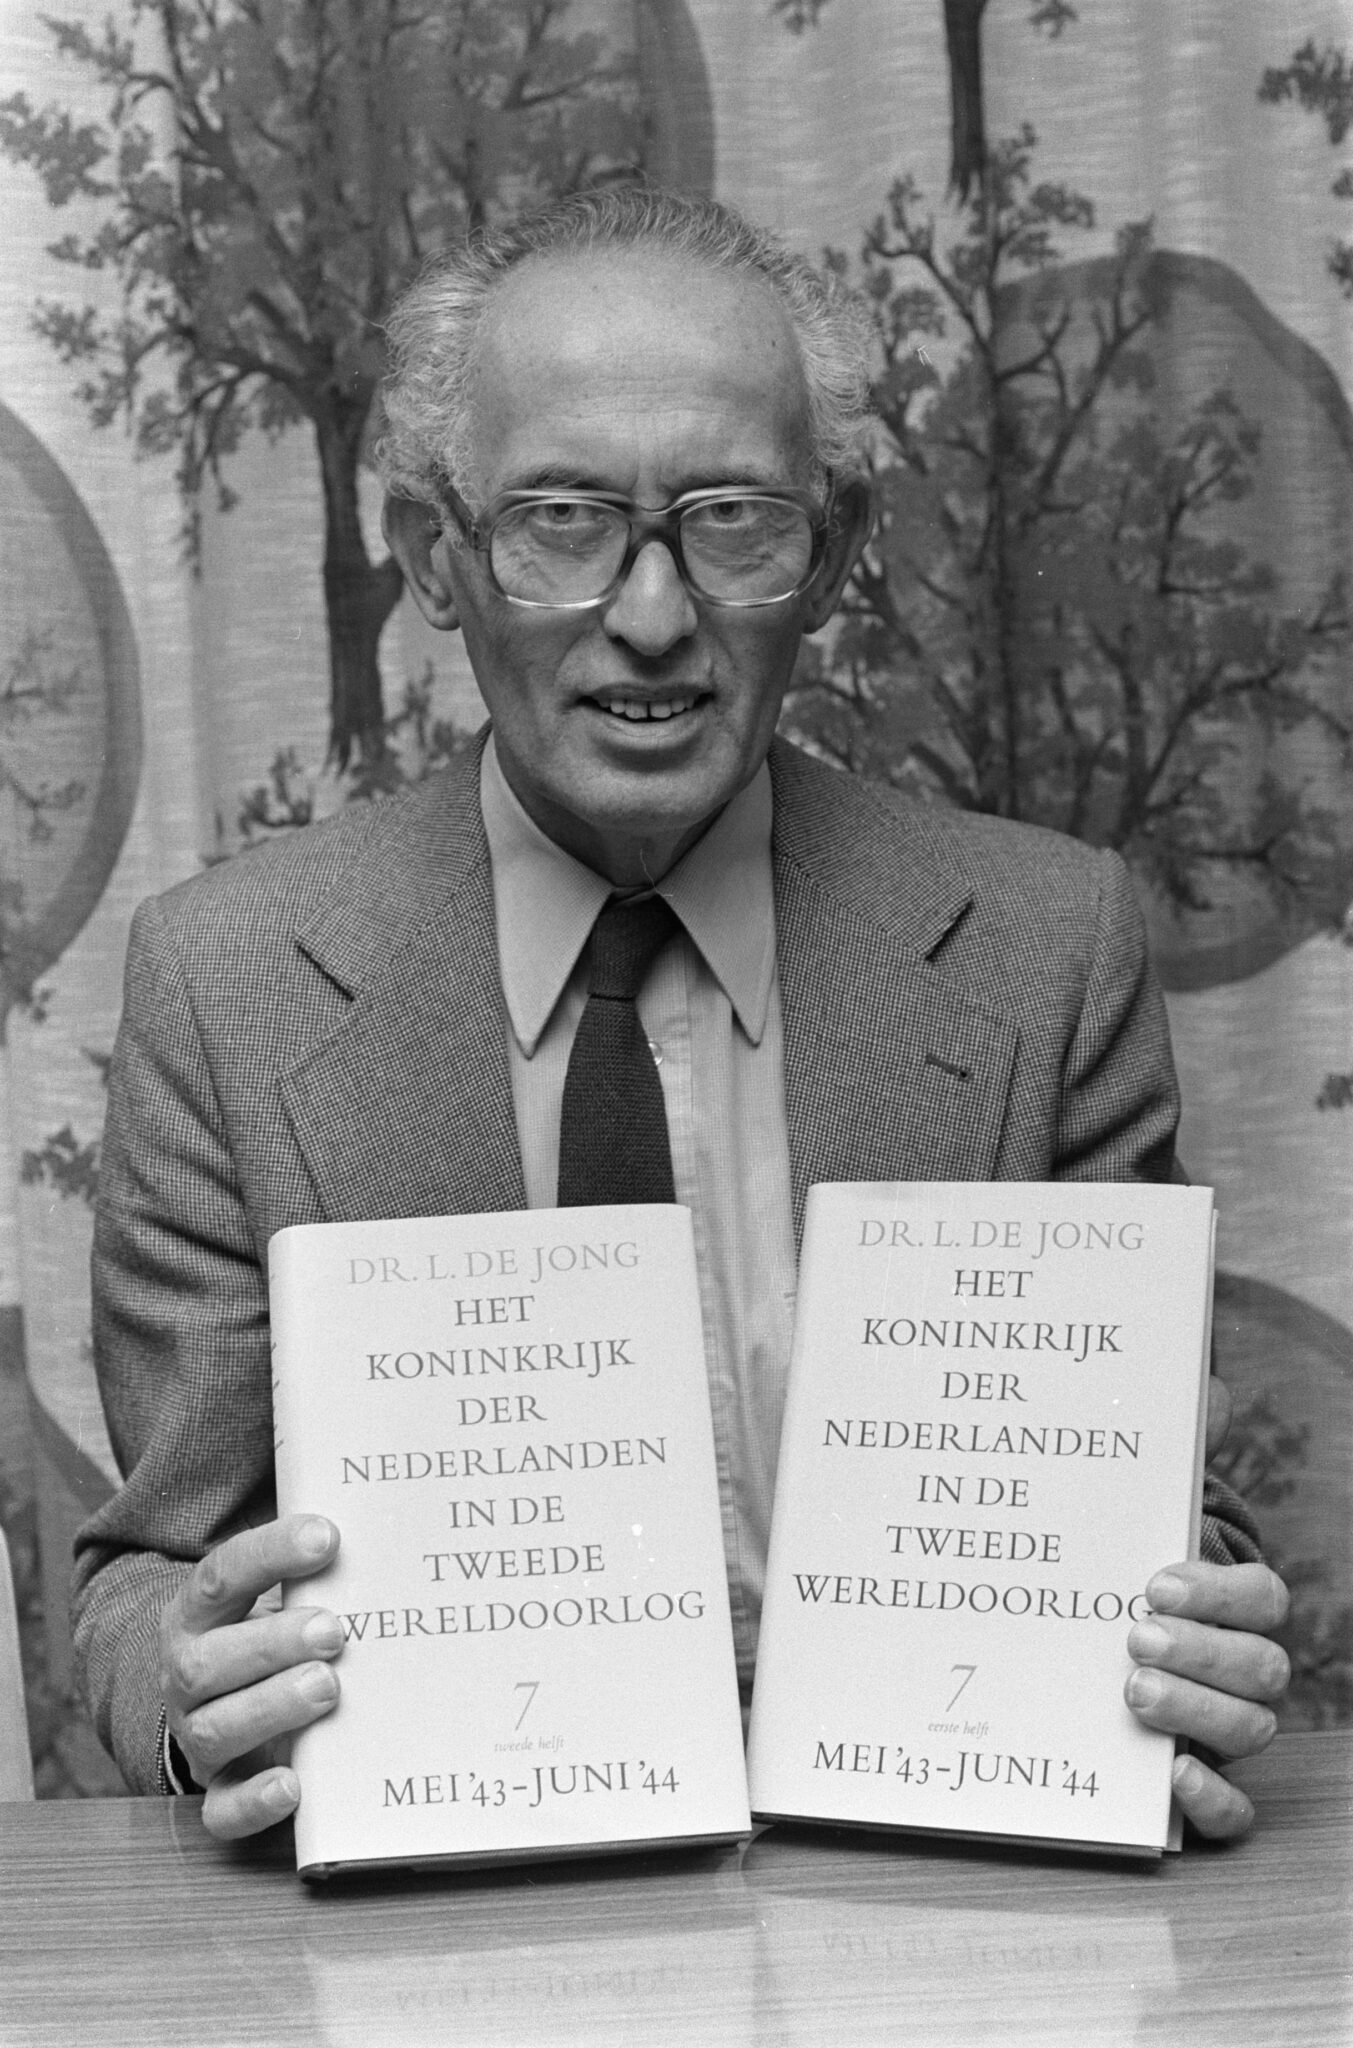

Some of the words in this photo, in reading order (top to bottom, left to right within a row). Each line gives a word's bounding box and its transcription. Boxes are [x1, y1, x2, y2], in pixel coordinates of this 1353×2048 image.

[858, 1220, 924, 1247] DR.
[933, 1221, 961, 1248] L.
[970, 1221, 1022, 1248] DE
[1031, 1221, 1145, 1260] JONG
[348, 1257, 418, 1285] DR.
[427, 1254, 456, 1281] L.
[464, 1249, 518, 1278] DE
[530, 1241, 640, 1284] JONG
[954, 1270, 1033, 1298] HET
[455, 1295, 535, 1326] HET
[367, 1339, 635, 1380] KONINKRIJK
[862, 1318, 1122, 1363] KONINKRIJK
[942, 1372, 1027, 1402] DER
[458, 1395, 547, 1426] DER
[823, 1419, 1141, 1459] NEDERLANDEN
[342, 1437, 666, 1484] NEDERLANDEN
[918, 1475, 964, 1504] IN
[976, 1478, 1028, 1507] DE
[449, 1499, 495, 1528] IN
[510, 1495, 564, 1525] DE
[423, 1544, 605, 1582] TWEEDE
[886, 1525, 1060, 1563] TWEEDE
[337, 1591, 705, 1642] WERELDOORLOG
[514, 1681, 540, 1731] 7
[946, 1664, 978, 1712] 7
[494, 1736, 534, 1752] tweede
[538, 1735, 565, 1753] helft
[927, 1722, 960, 1734] eerste
[963, 1720, 990, 1740] helft
